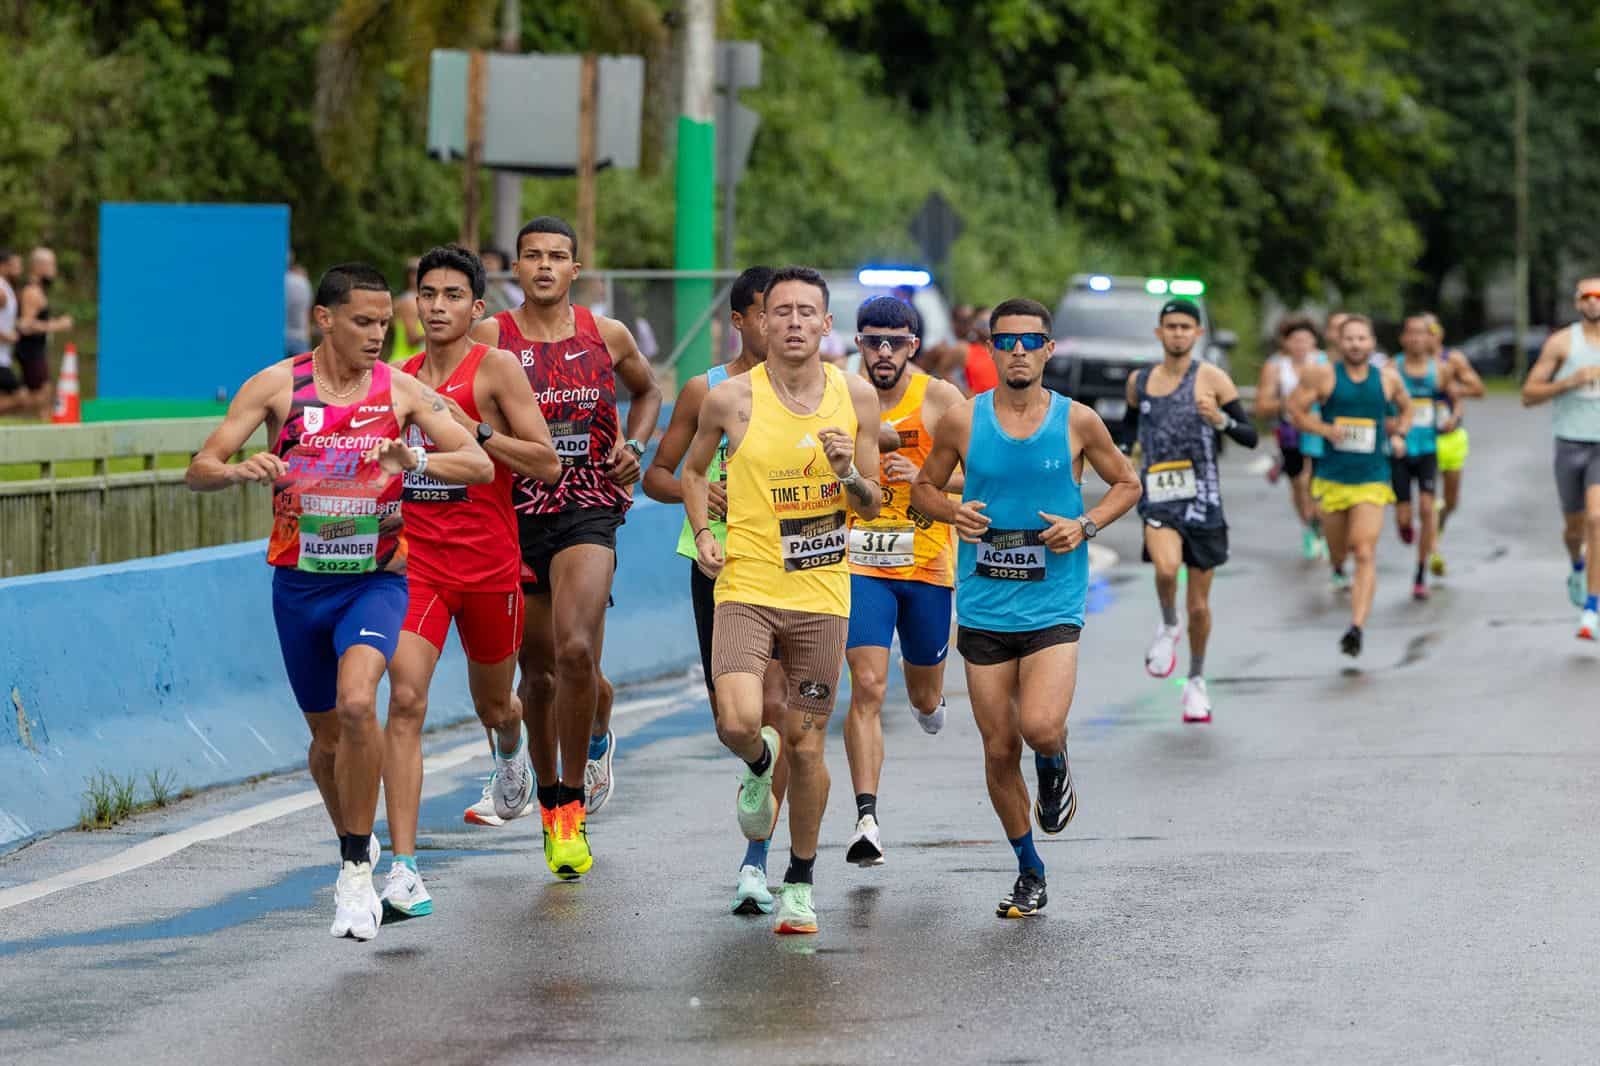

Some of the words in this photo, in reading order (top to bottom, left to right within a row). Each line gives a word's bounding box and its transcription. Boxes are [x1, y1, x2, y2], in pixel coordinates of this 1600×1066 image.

[533, 386, 600, 405] edicentro
[300, 432, 384, 450] Credicentro
[412, 490, 450, 500] 2025
[770, 486, 801, 503] TIME
[304, 541, 374, 555] ALEXANDER
[790, 531, 845, 554] PAGÁN
[862, 532, 900, 553] 317
[800, 554, 841, 569] 2025
[983, 550, 1038, 565] ACABA
[316, 560, 361, 572] 2022
[989, 568, 1029, 580] 2025
